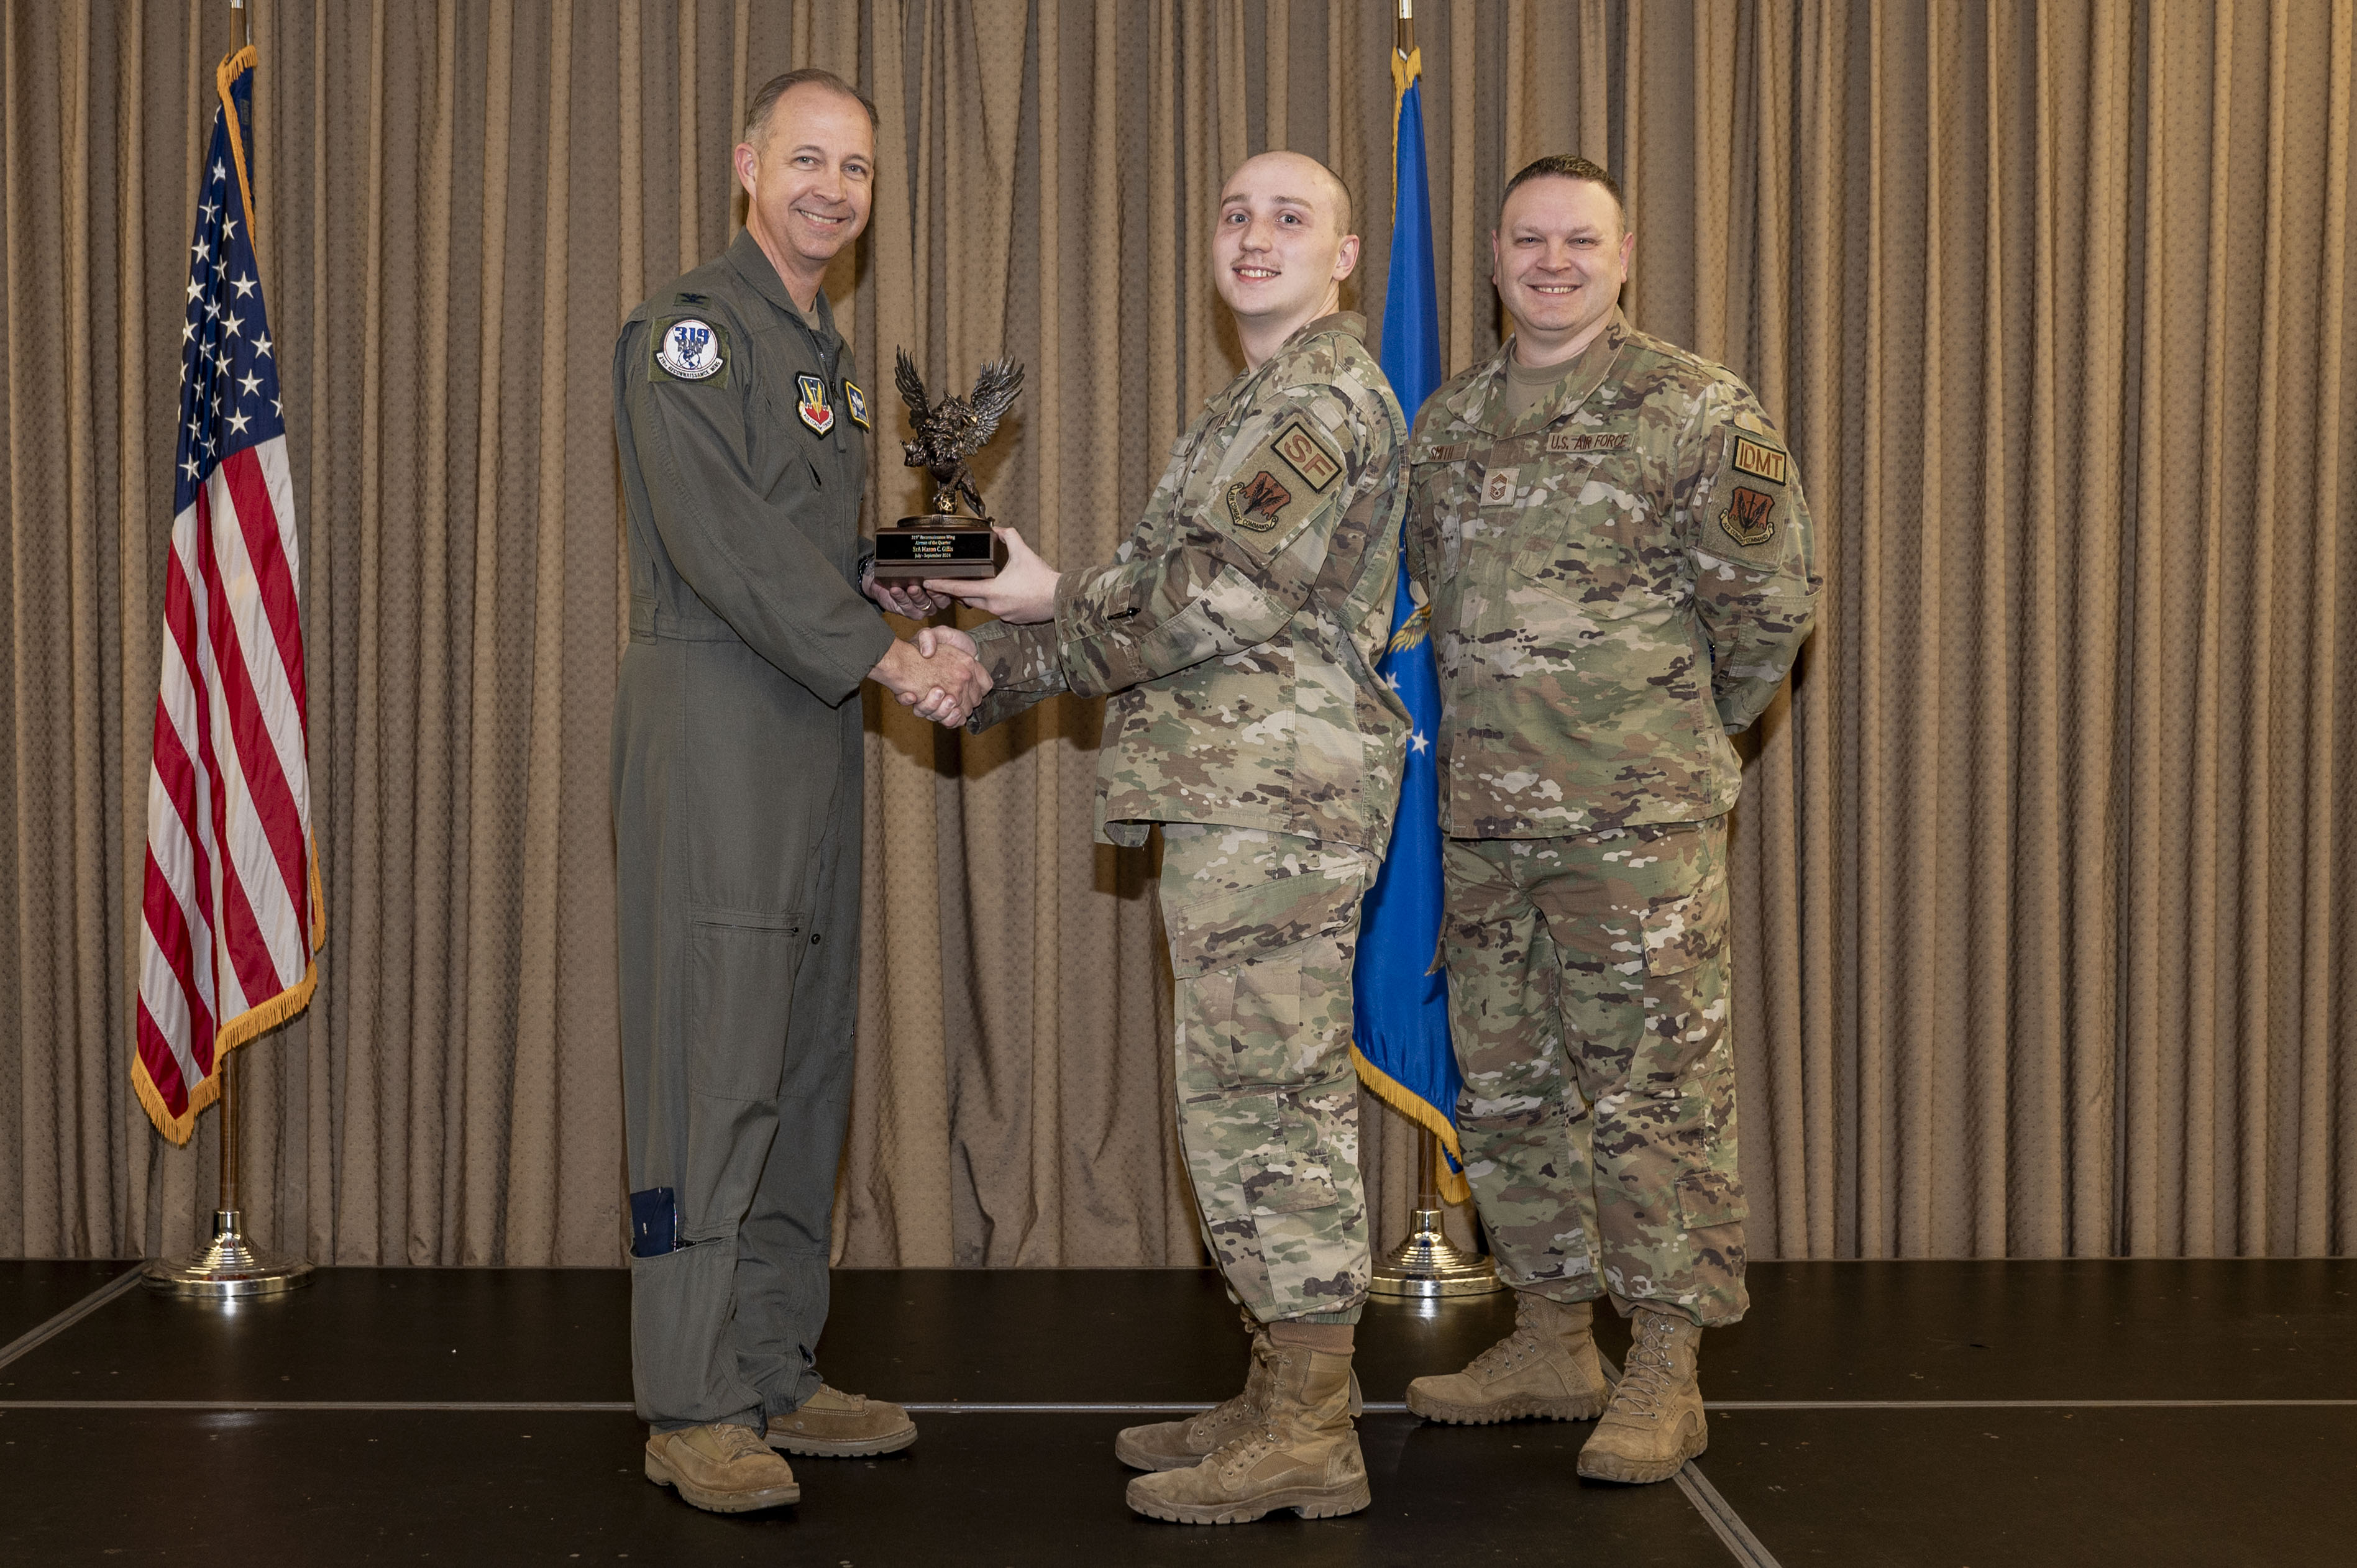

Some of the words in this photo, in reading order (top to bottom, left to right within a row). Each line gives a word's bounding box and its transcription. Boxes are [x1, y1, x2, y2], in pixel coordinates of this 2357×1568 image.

[675, 327, 709, 345] 319
[668, 365, 710, 378] RECONNAISSANCE
[710, 361, 720, 371] WING
[1551, 435, 1568, 450] U.S.
[1573, 435, 1592, 450] AIR
[1594, 434, 1629, 448] FORCE
[1284, 434, 1334, 476] SF
[1739, 442, 1783, 478] IDMT
[1230, 501, 1242, 523] COMBAT
[1243, 519, 1270, 530] COMMAND
[1723, 522, 1731, 531] AIR
